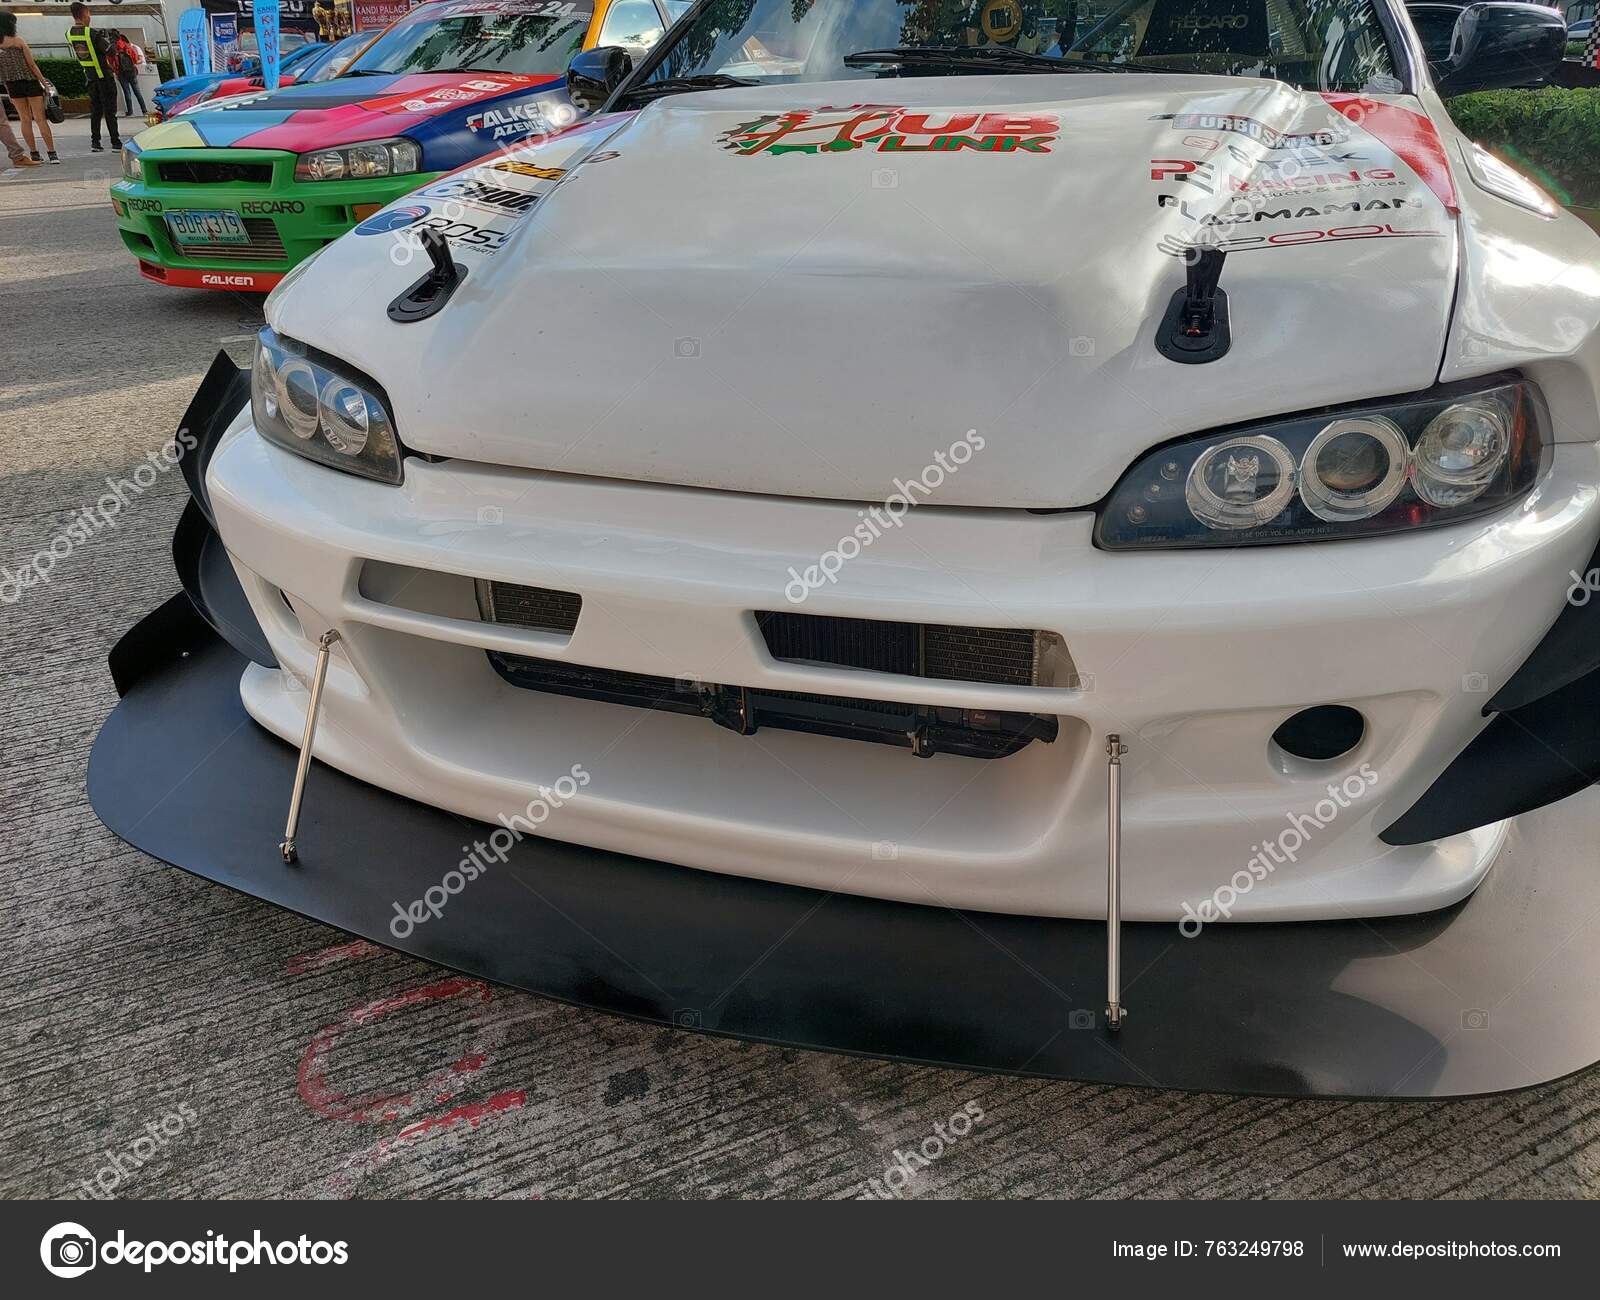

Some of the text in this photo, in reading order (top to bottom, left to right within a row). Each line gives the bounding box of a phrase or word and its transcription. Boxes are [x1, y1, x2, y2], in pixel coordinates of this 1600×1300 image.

[1168, 14, 1249, 29] RECARO
[875, 136, 1053, 153] LINK
[128, 198, 305, 215] RECARO RECARO
[202, 274, 254, 286] FALKEN
